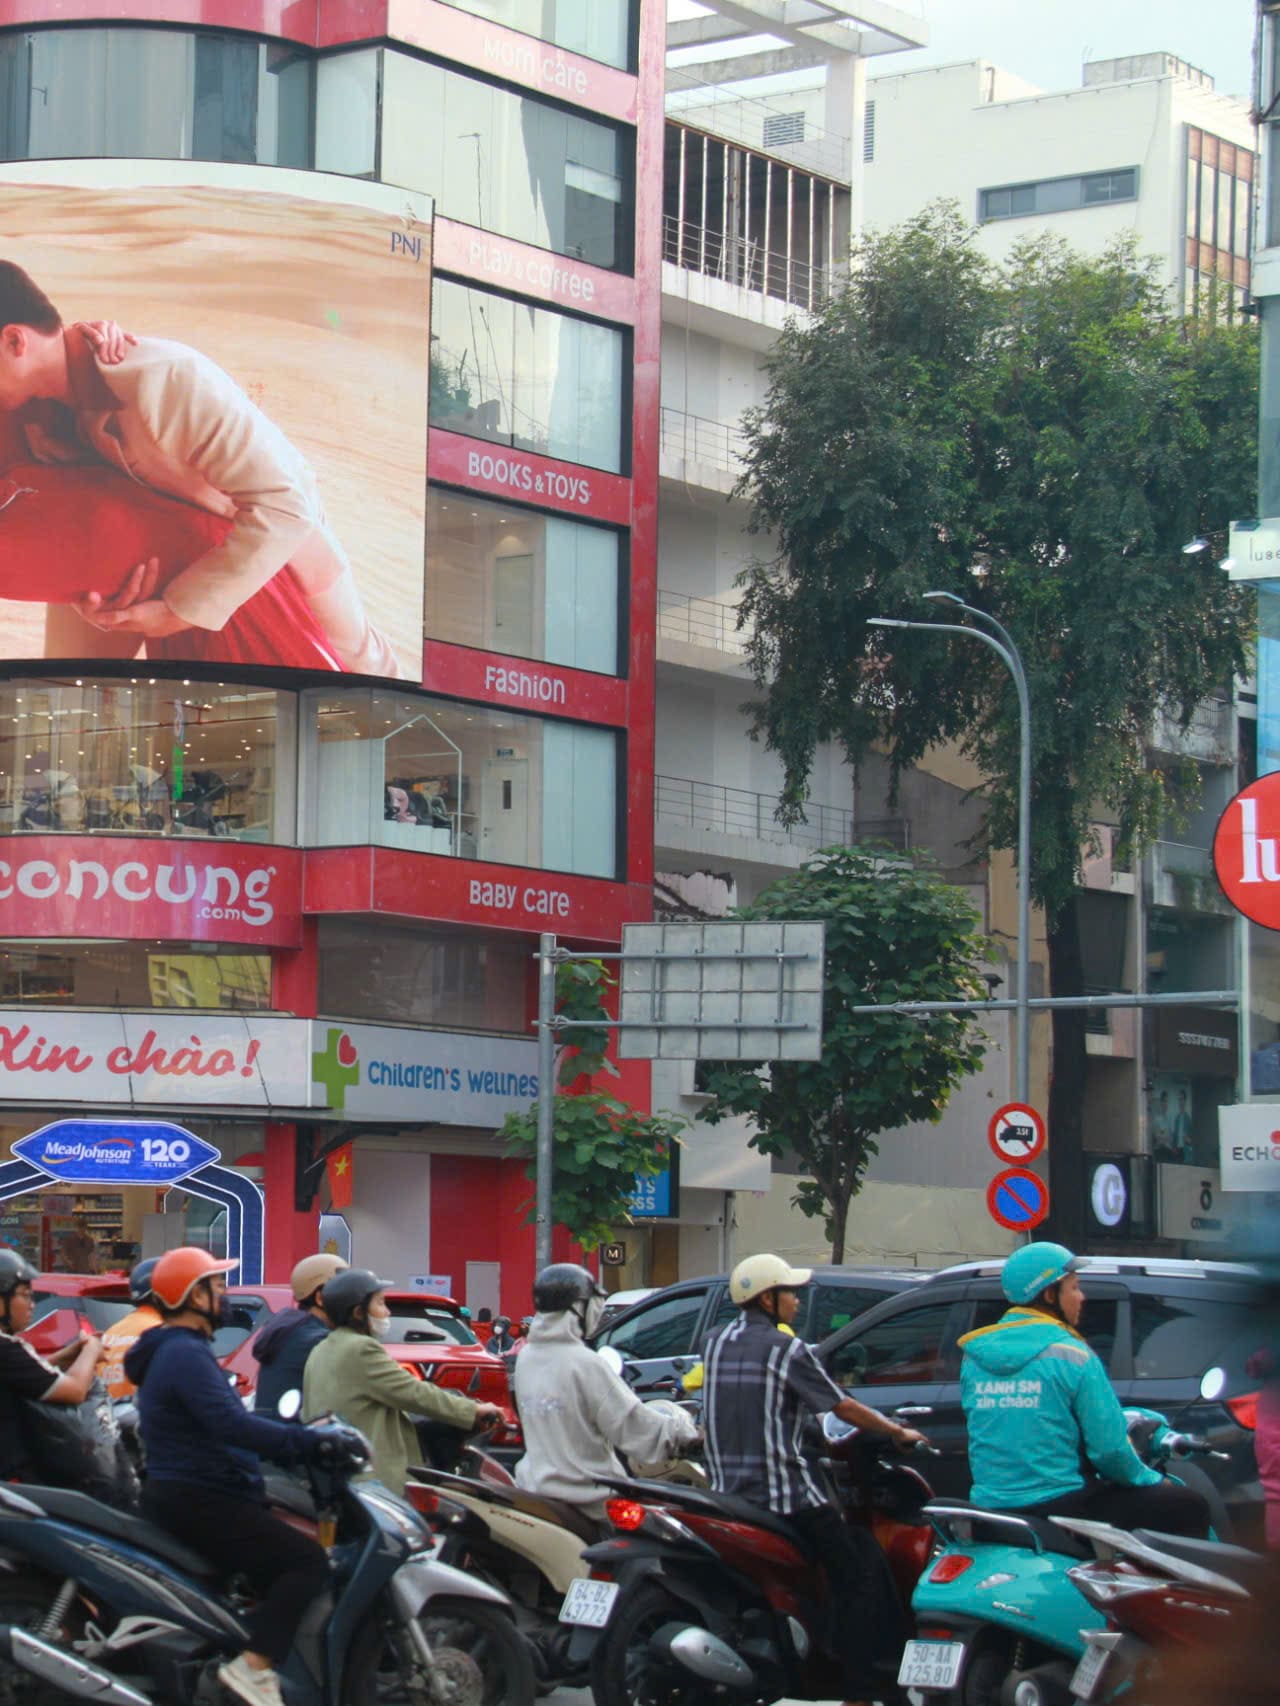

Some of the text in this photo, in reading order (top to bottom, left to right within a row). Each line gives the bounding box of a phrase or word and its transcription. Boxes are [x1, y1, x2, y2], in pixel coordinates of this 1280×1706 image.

[391, 231, 421, 261] PNJ
[106, 1029, 262, 1079] chào!
[141, 1138, 190, 1163] 120
[975, 1380, 1042, 1394] XANH SM
